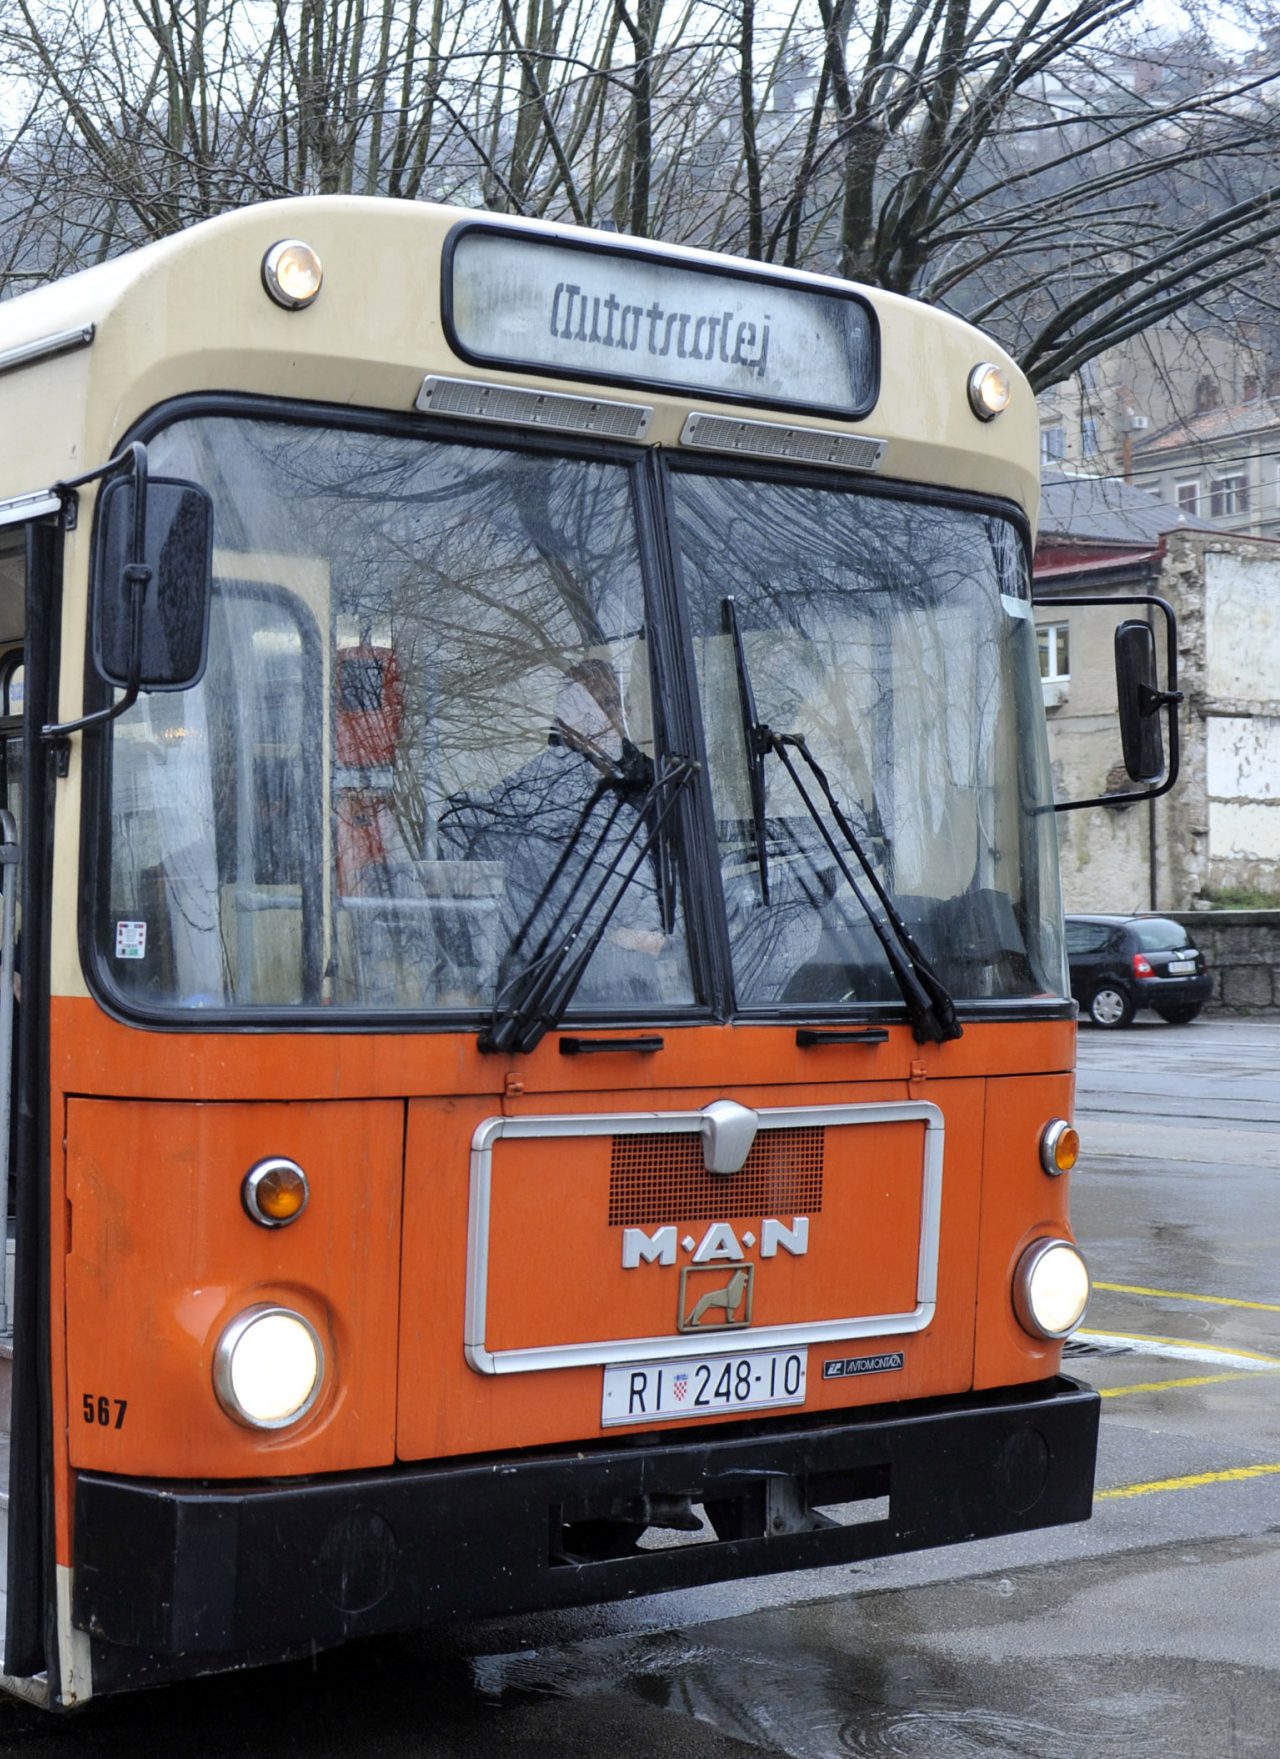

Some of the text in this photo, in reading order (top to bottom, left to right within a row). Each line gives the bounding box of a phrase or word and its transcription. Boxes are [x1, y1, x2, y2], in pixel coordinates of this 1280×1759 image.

[629, 1354, 801, 1414] RI 248-10
[83, 1393, 128, 1430] 567
